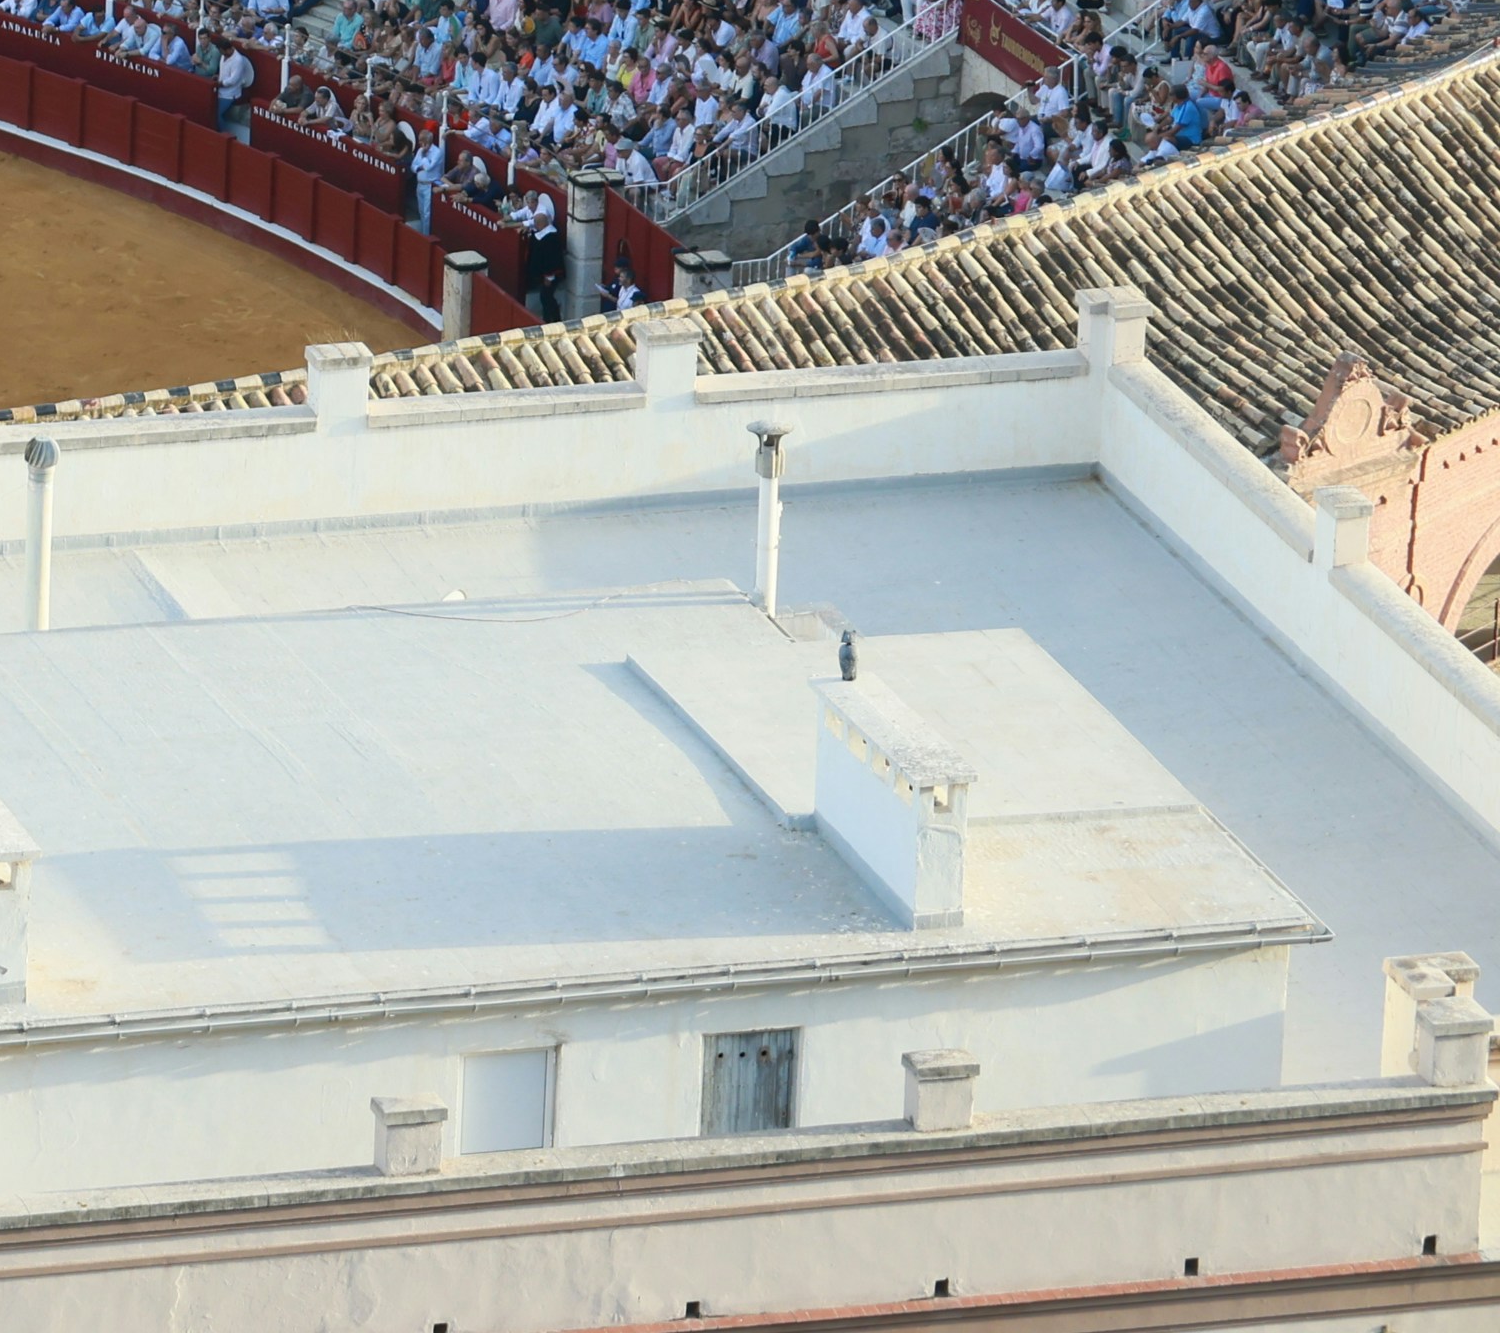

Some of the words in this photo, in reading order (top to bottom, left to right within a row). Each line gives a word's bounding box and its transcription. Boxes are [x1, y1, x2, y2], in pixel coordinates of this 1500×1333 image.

[1, 20, 61, 46] ANDALUCIA
[95, 50, 159, 78] DIPUTACION
[253, 106, 328, 144] SUBDELEGACION
[331, 138, 348, 153] DEL
[353, 148, 396, 175] GOBIERNO
[452, 201, 498, 232] AUTORIDAD
